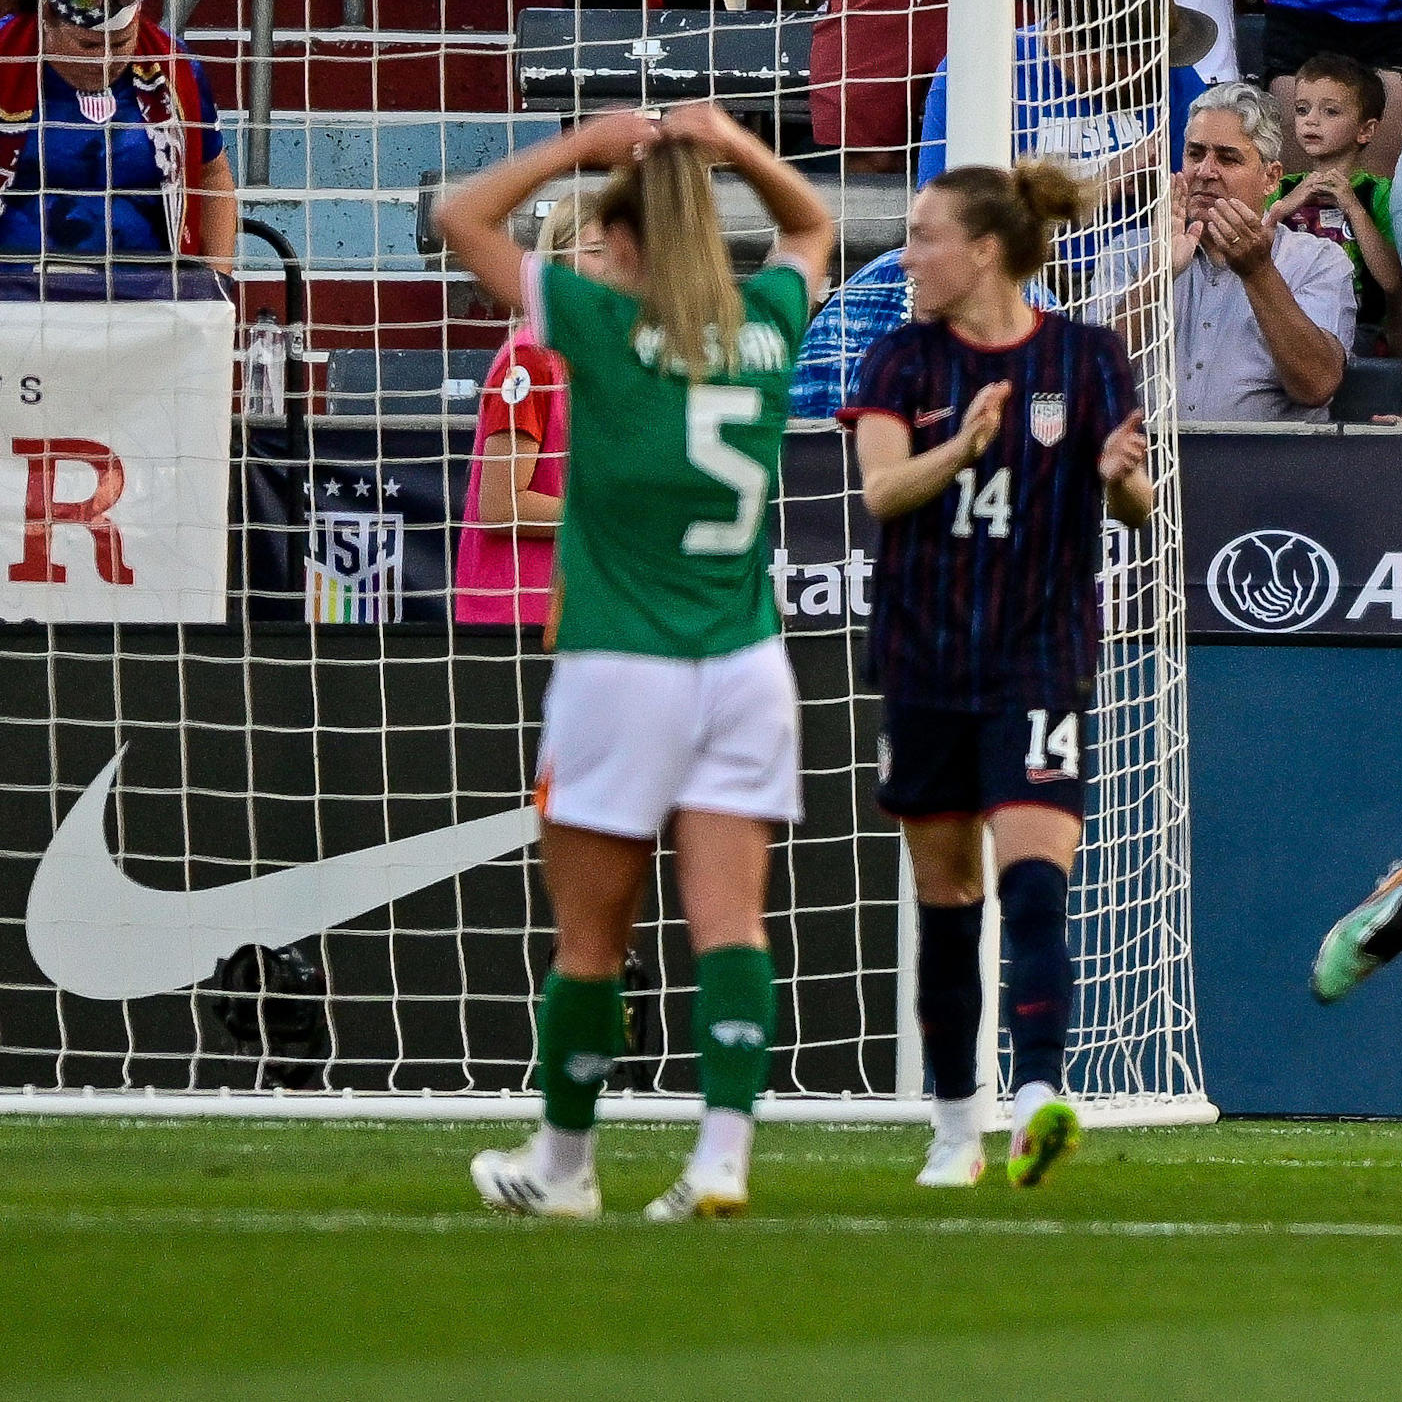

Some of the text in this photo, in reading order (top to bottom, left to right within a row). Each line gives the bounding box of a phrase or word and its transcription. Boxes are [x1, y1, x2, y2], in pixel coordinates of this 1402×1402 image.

[8, 437, 135, 585] R
[681, 384, 763, 556] 5
[951, 467, 1013, 539] 14
[1024, 708, 1080, 779] 14
